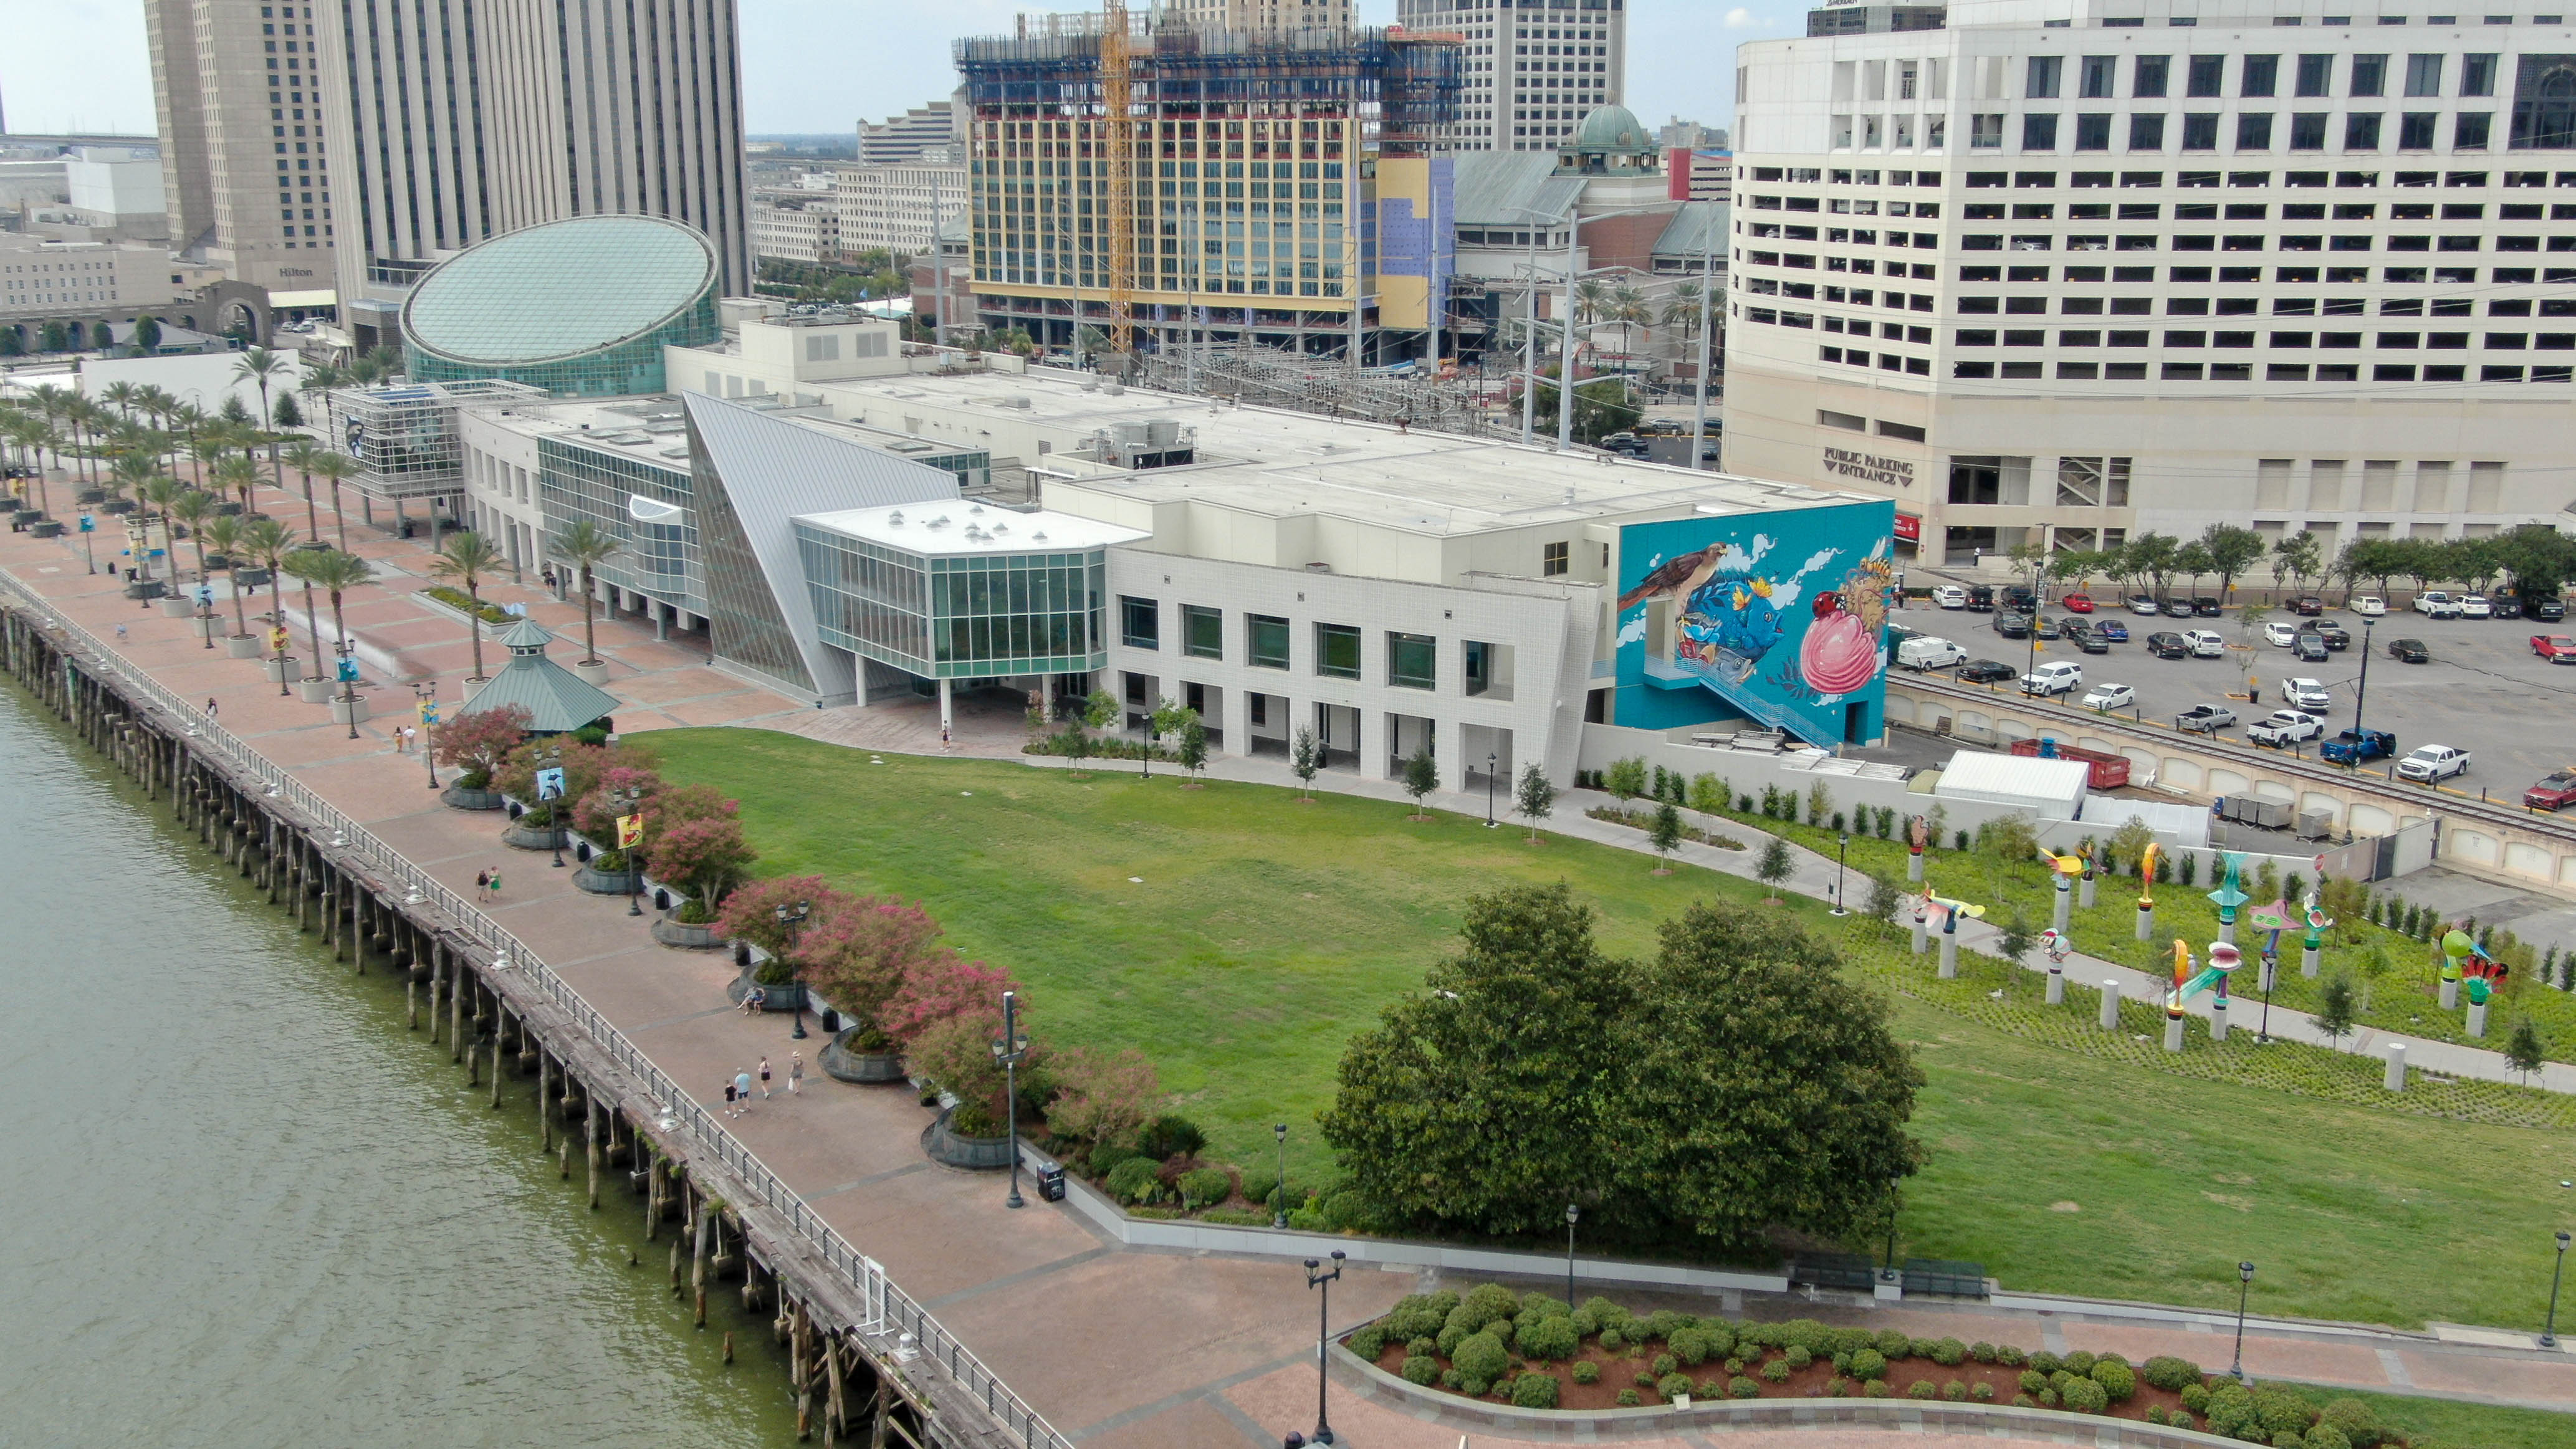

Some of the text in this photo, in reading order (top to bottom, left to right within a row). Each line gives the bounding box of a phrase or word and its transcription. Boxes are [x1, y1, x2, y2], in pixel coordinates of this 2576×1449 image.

[279, 267, 313, 277] Hilton
[1824, 447, 1913, 475] PUBLIC PARKING
[1838, 462, 1896, 485] ENTRANCE
